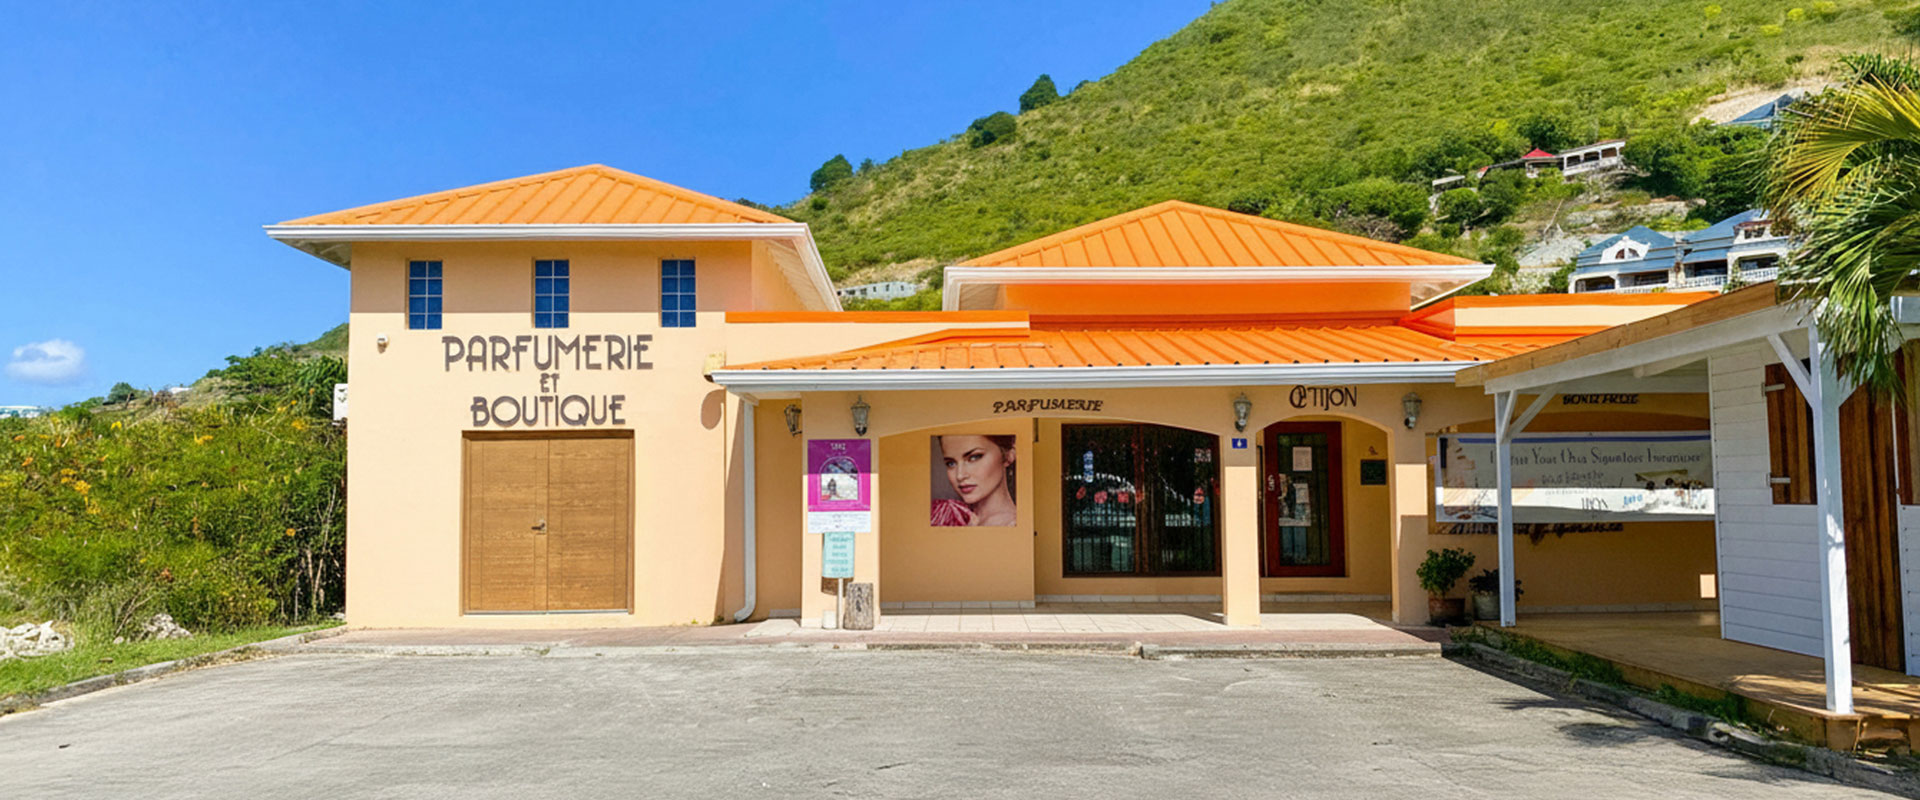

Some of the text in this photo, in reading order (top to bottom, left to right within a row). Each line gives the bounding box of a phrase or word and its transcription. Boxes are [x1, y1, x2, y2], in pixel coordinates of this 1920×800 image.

[441, 334, 653, 372] PARFUMERIE
[539, 373, 560, 393] ET
[470, 394, 626, 428] BOUTIQUE
